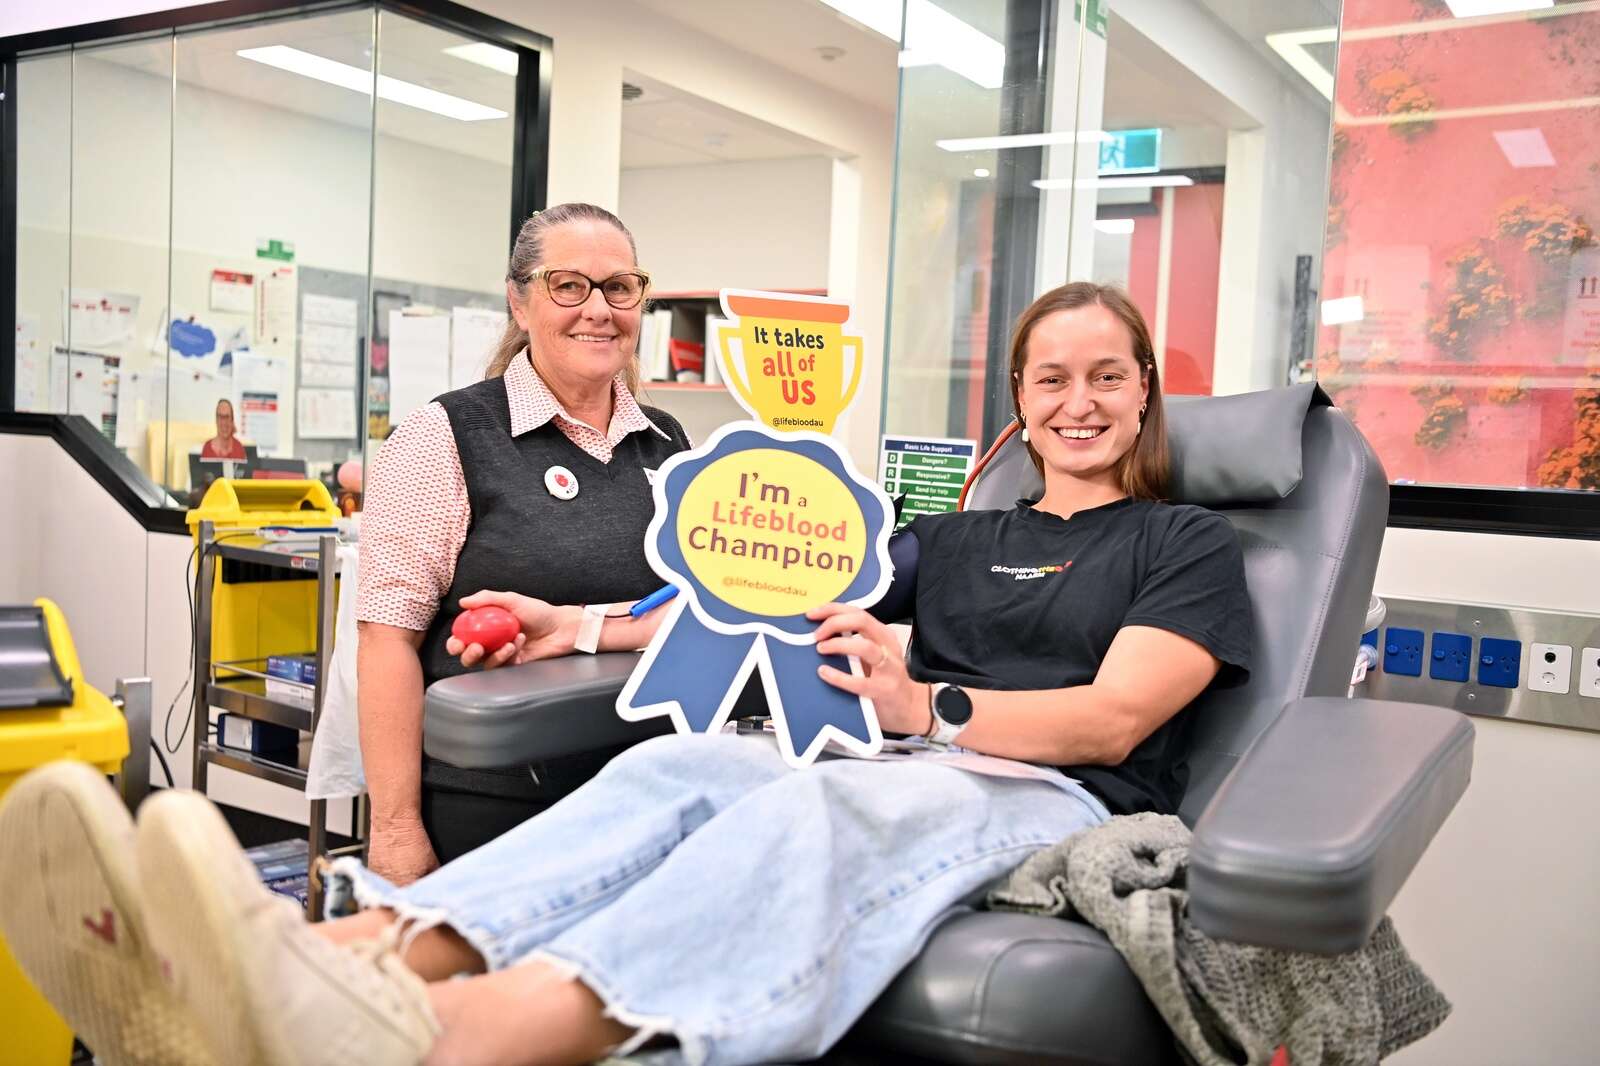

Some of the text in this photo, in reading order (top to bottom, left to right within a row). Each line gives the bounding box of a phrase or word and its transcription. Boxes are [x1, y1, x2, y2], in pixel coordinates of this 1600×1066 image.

[754, 326, 825, 350] It takes
[762, 351, 816, 377] all of
[772, 417, 824, 427] @lifebloodau
[889, 454, 896, 462] D
[904, 443, 953, 454] Basic Life Support
[887, 468, 895, 477] R
[739, 472, 807, 507] I'm a
[886, 483, 893, 491] S
[712, 501, 847, 542] Lifeblood
[688, 526, 854, 573] Champion
[722, 575, 808, 597] @lifebloodau
